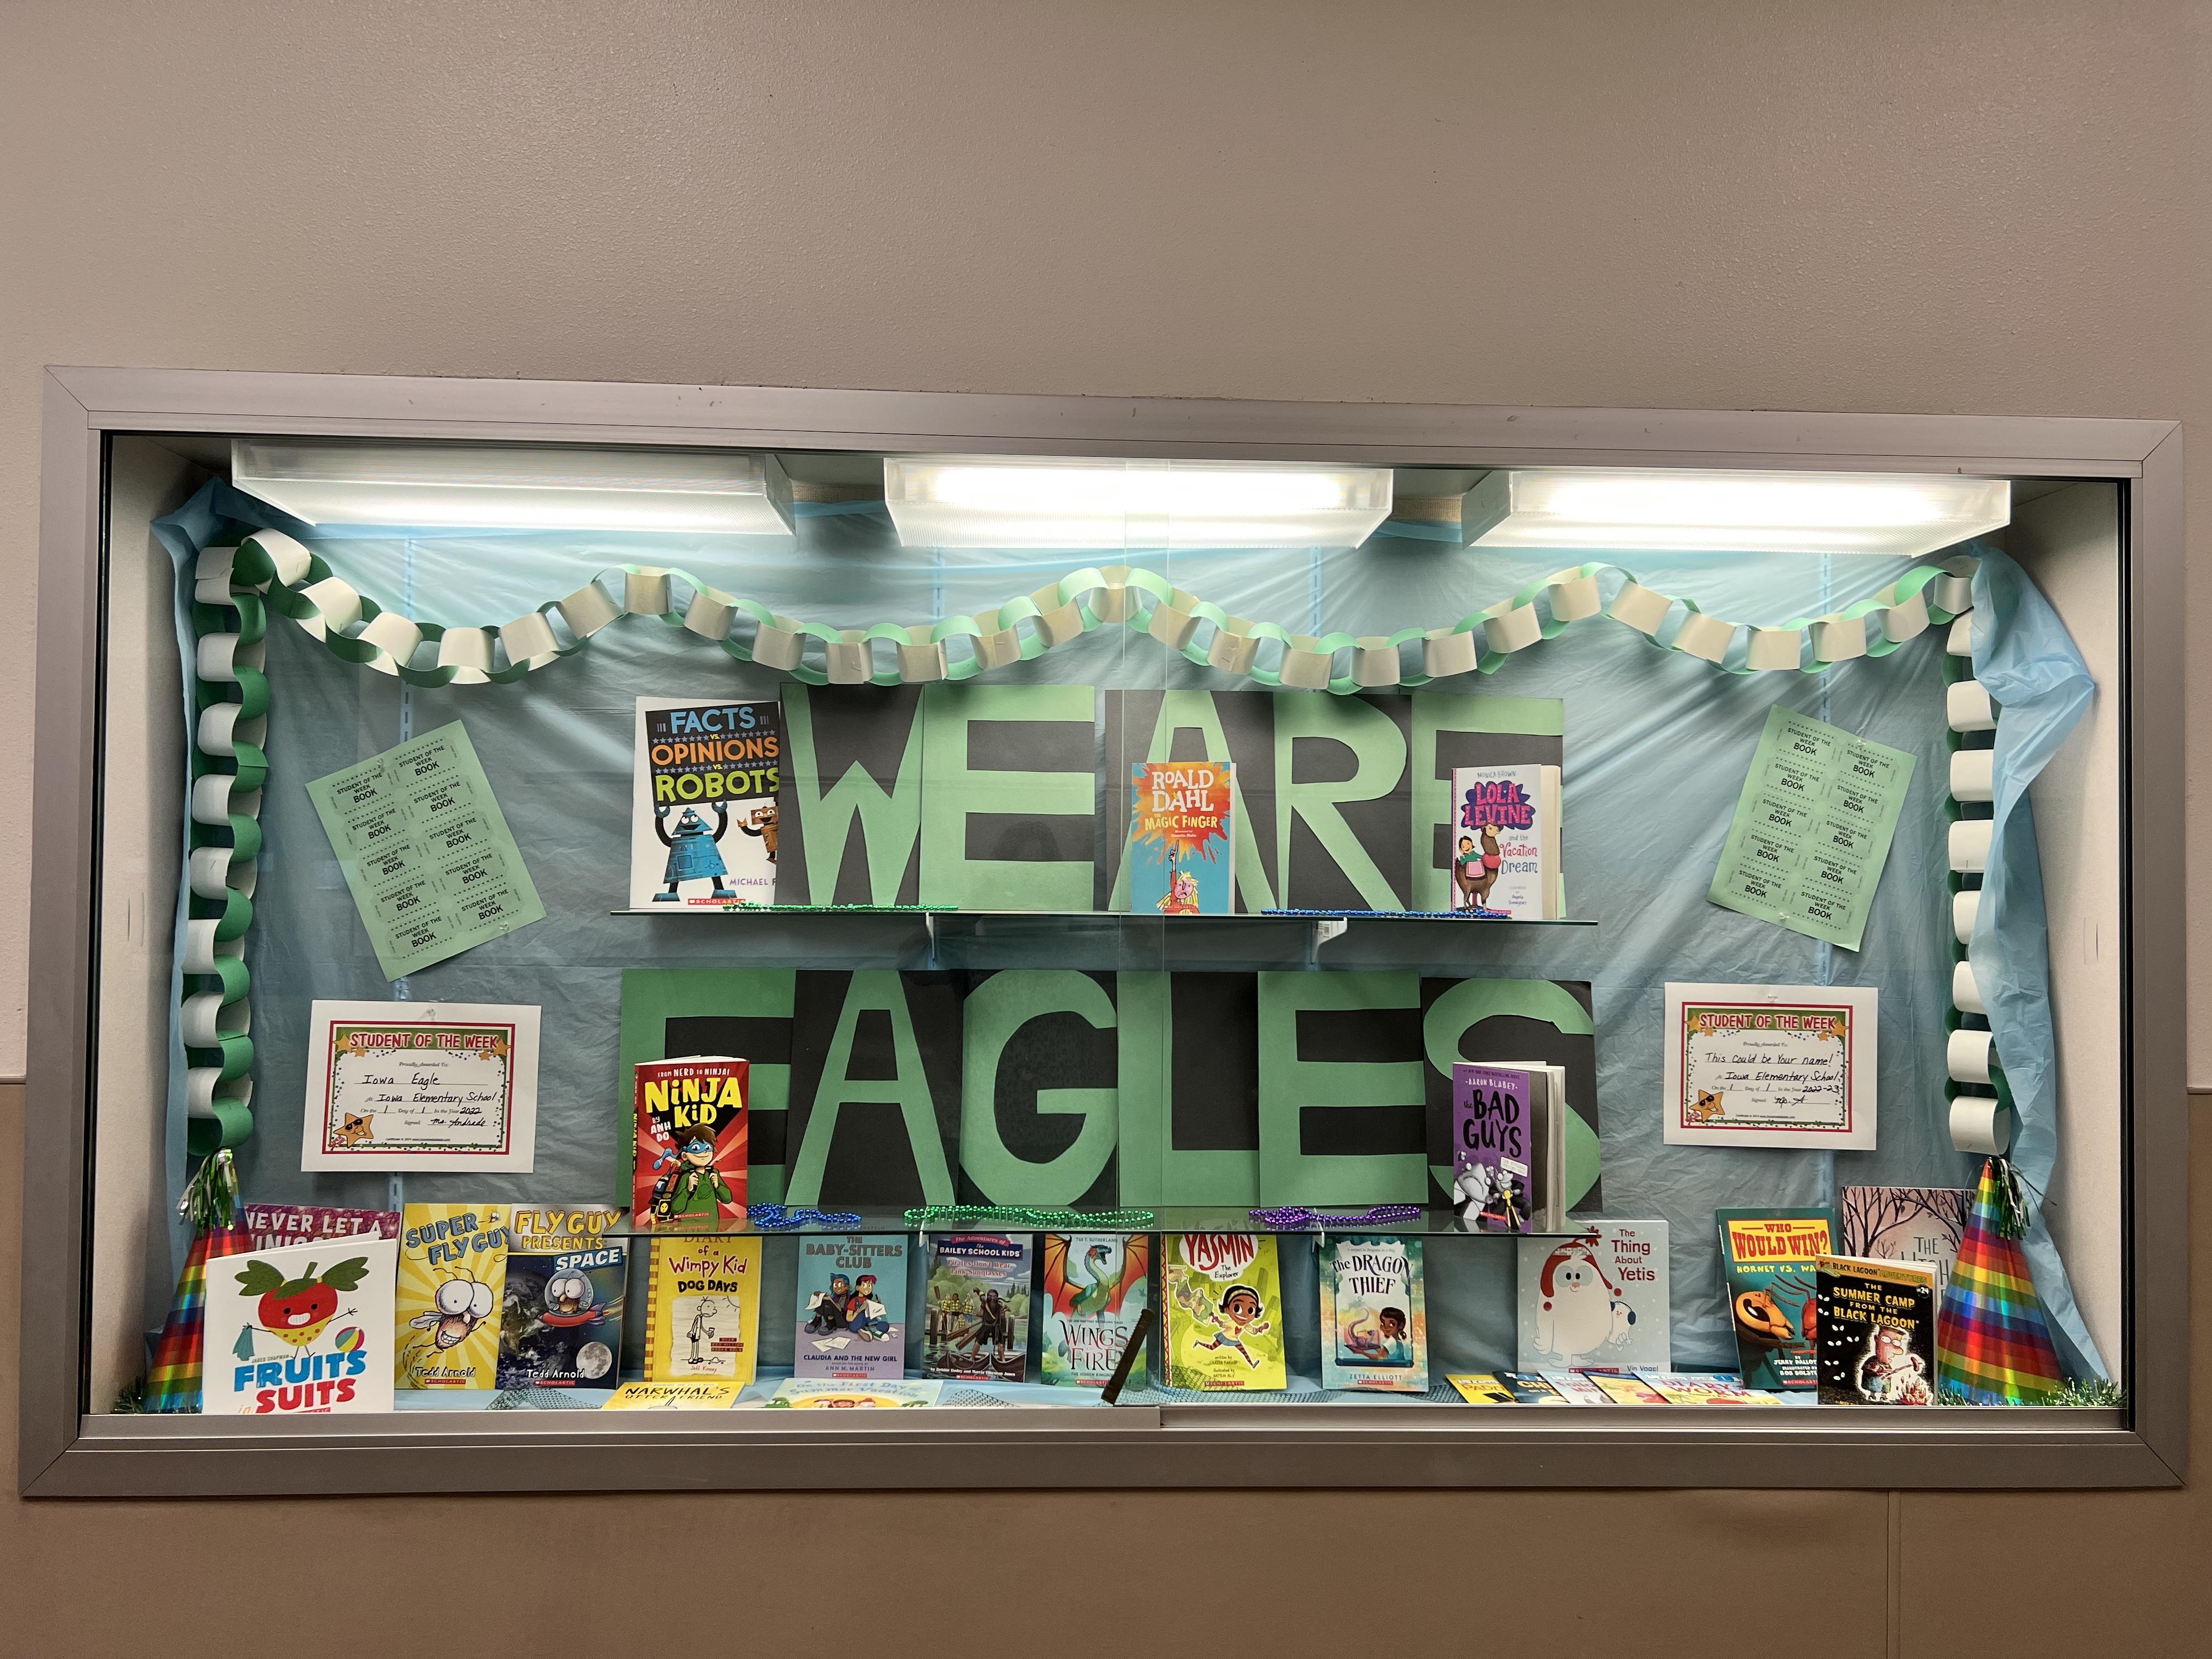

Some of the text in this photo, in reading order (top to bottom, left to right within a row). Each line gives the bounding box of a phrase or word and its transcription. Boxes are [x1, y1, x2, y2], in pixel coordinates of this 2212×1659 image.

[670, 706, 756, 734] FACTS
[1787, 727, 1812, 739] STUDENT
[1794, 742, 1817, 755] BOOK
[1800, 738, 1815, 746] WEEK
[651, 737, 780, 765] OPINIONS
[399, 754, 424, 768] STUDENT
[415, 757, 432, 766] WEEK
[415, 761, 439, 776] BOOK
[655, 768, 780, 803] ROBOTS
[1152, 769, 1214, 790] ROALD
[781, 684, 1565, 918] WE ARE
[1152, 789, 1214, 812] DAHL
[1475, 783, 1520, 804] LOLA
[1465, 805, 1531, 825] LEVINE
[1145, 816, 1218, 831] MAGIC FINGER
[1500, 842, 1537, 857] Vacation
[1502, 860, 1538, 874] Dream
[1801, 891, 1826, 903] STUDENT
[1808, 906, 1832, 920] BOOK
[1815, 902, 1830, 911] WEEK
[1700, 1013, 1836, 1029] STUDENT OF THE WEEK
[351, 1033, 499, 1049] STUDENT OF THE WEEK
[1705, 1052, 1725, 1062] This
[1762, 1053, 1771, 1064] be
[1778, 1054, 1797, 1064] Your
[674, 1068, 693, 1077] NERD
[1725, 1070, 1839, 1085] Iowa Elementary School
[362, 1073, 440, 1090] Iowa Eagle
[619, 969, 1601, 1210] EAGLES
[413, 1092, 463, 1107] Elementary
[466, 1092, 497, 1102] School
[1464, 1100, 1474, 1109] the
[1473, 1089, 1519, 1124] BAD
[651, 1121, 671, 1135] ANH
[657, 1133, 670, 1143] DO
[1463, 1119, 1522, 1158] GUYS
[322, 1217, 363, 1235] LET
[369, 1220, 382, 1237] A
[515, 1210, 622, 1235] FLY GUY
[1764, 1223, 1792, 1233] WHO
[406, 1212, 478, 1249] SUPER
[1619, 1229, 1635, 1237] The
[522, 1235, 603, 1250] PRESENTS
[1611, 1240, 1650, 1255] Thing
[1733, 1231, 1828, 1260] WOULD WIN?
[1914, 1237, 1939, 1255] THE
[428, 1237, 469, 1265] FLY
[698, 1245, 708, 1256] of
[806, 1244, 902, 1257] BABY-SITTERS
[1184, 1234, 1255, 1271] YASMIN
[555, 1249, 619, 1272] SPACE
[669, 1255, 747, 1278] Wimpy Kid
[836, 1257, 872, 1268] CLUB
[1330, 1254, 1414, 1277] The DRAGON
[1615, 1256, 1642, 1264] About
[968, 1269, 1007, 1277] Sunglasses
[1618, 1267, 1655, 1281] Yetis
[1780, 1265, 1796, 1273] VS.
[1833, 1262, 1927, 1283] BLACK LAGOON ADVENTURES
[678, 1280, 738, 1293] DOG DAYS
[1349, 1277, 1396, 1296] THIEF
[1833, 1287, 1915, 1308] SUMMER CAMP
[1850, 1302, 1875, 1311] FROM
[1833, 1306, 1915, 1330] BLACK LAGOON
[1059, 1320, 1128, 1350] WINGS
[1071, 1347, 1117, 1370] FIRE
[234, 1350, 367, 1392] FRUITS
[415, 1367, 476, 1378] Tedd Arnold
[527, 1369, 585, 1379] Tedd Arnold
[256, 1378, 357, 1414] SUITS
[625, 1387, 731, 1395] NARWHAL'S
